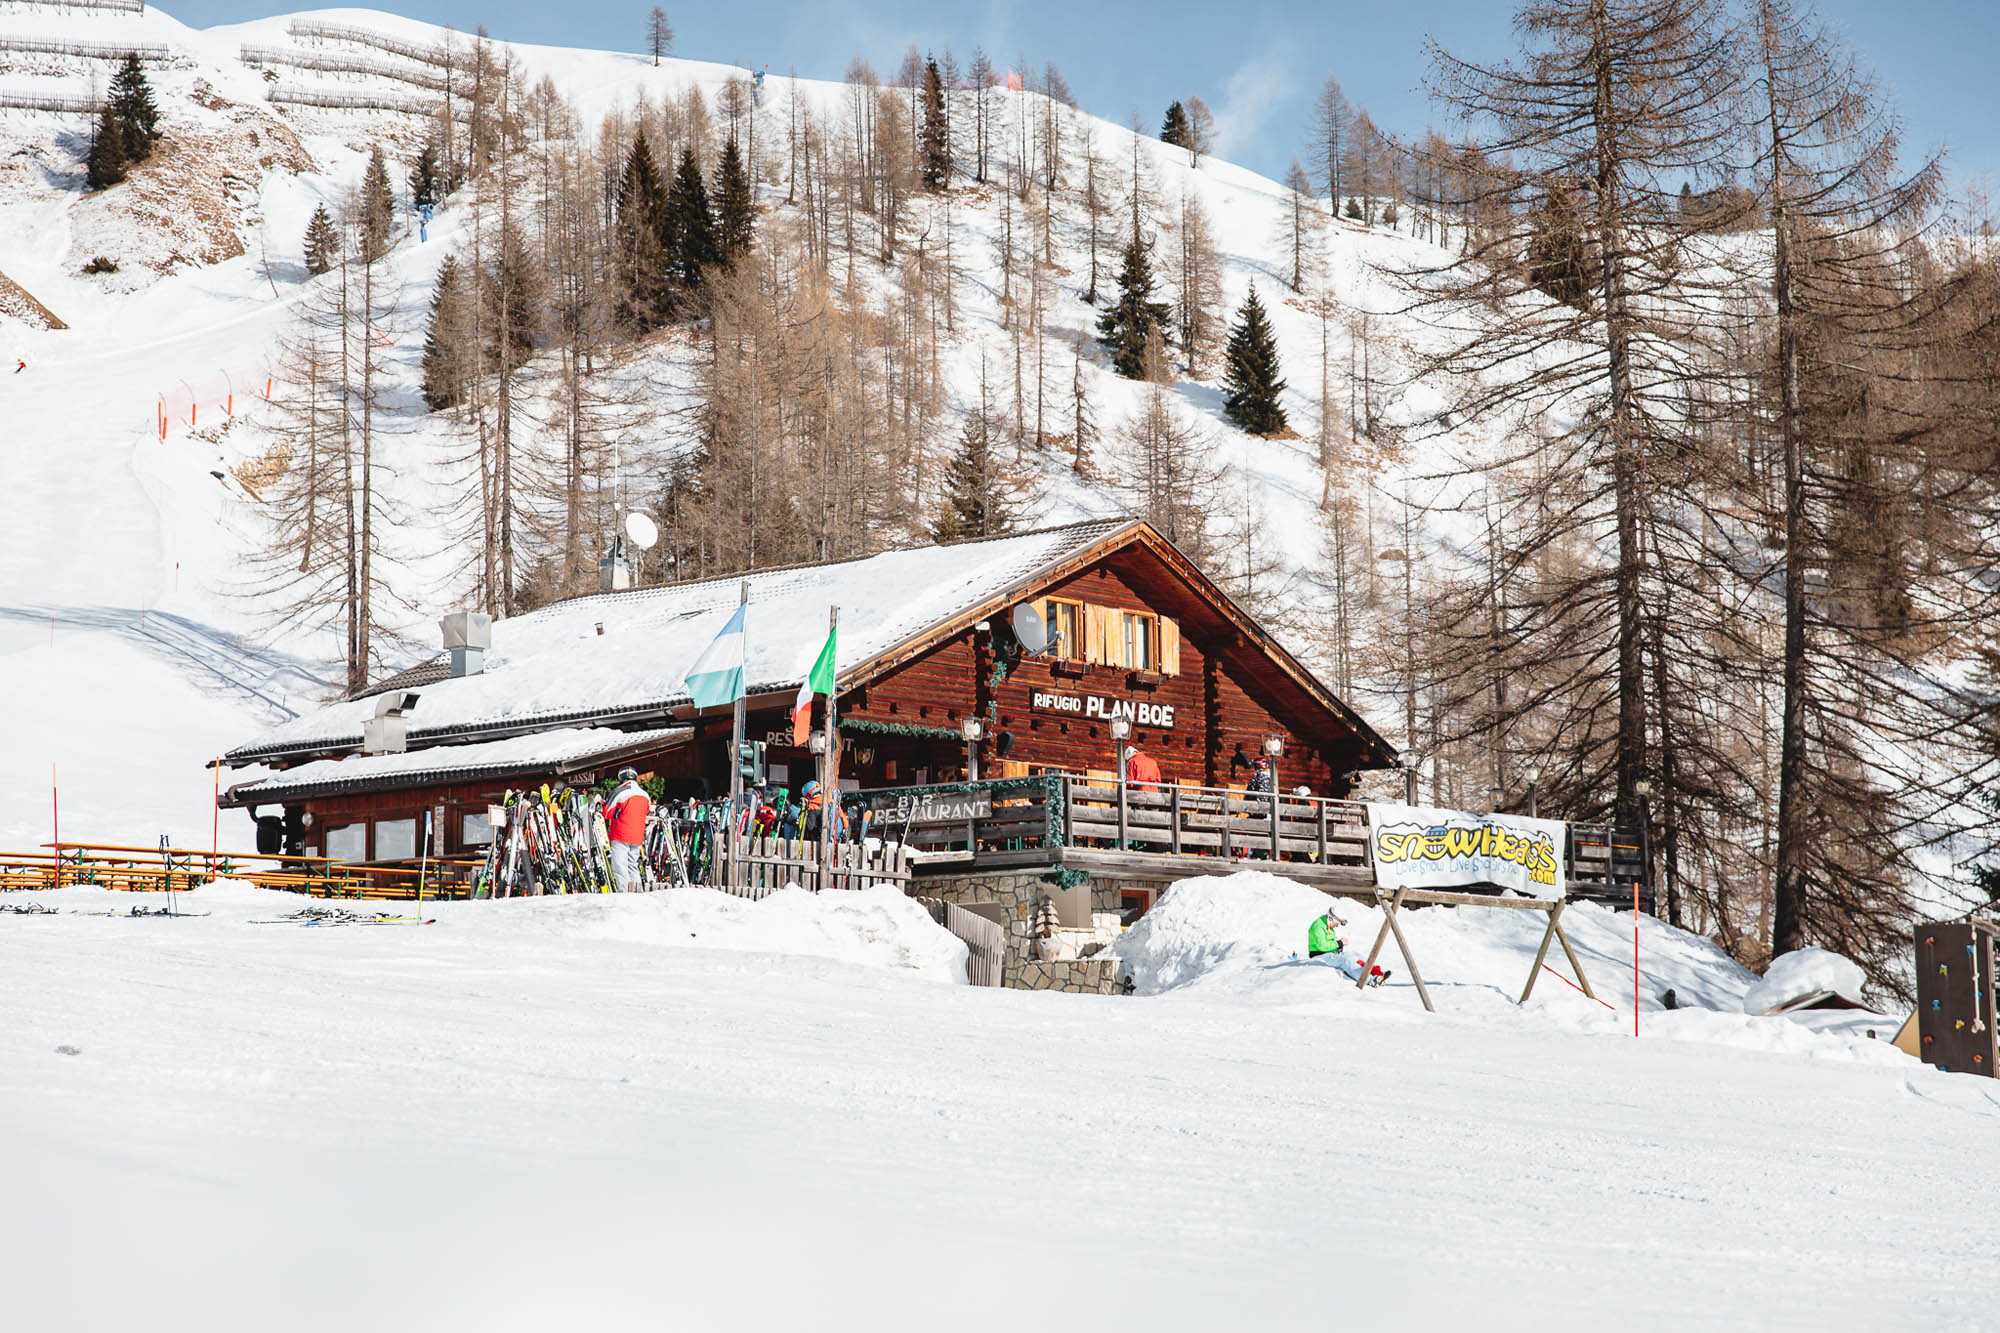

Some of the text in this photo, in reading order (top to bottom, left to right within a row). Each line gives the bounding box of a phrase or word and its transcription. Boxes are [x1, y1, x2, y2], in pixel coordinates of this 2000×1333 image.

[1033, 692, 1081, 712] RIFUGIO
[1085, 695, 1136, 721] PLAN
[1528, 868, 1556, 885] .com
